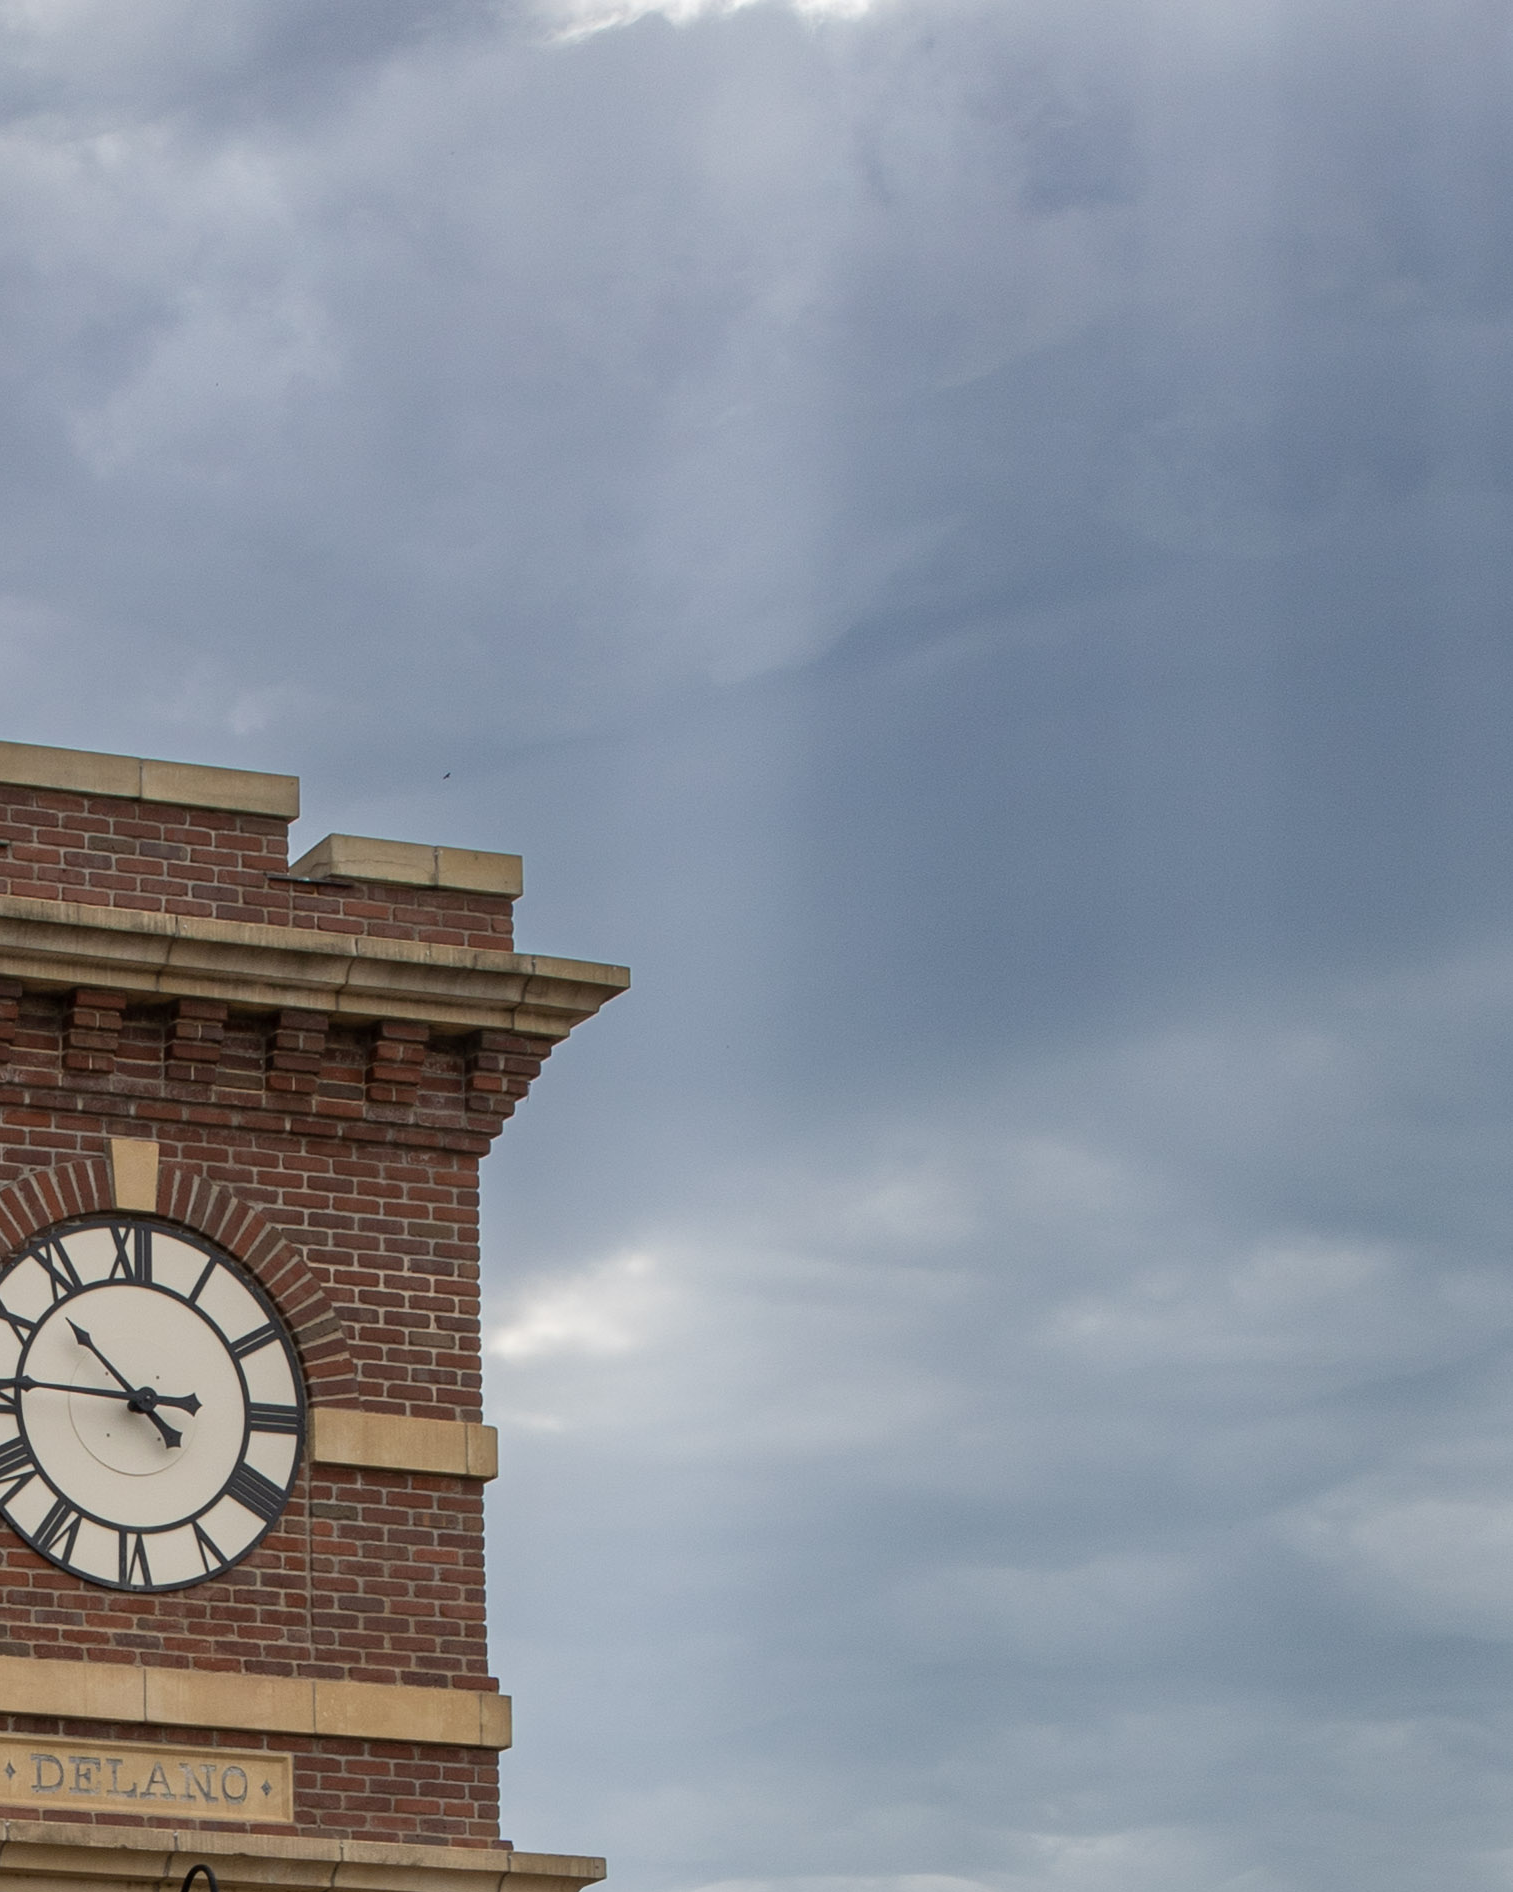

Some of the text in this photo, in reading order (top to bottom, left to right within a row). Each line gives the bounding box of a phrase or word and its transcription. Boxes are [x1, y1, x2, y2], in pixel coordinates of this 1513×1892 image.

[29, 1237, 84, 1304] XI
[108, 1226, 154, 1284] XII
[188, 1256, 219, 1304] I
[229, 1321, 282, 1361] II
[247, 1401, 299, 1436] III
[225, 1461, 287, 1525] IIII
[31, 1497, 83, 1566] VII
[118, 1530, 154, 1587] VI
[190, 1519, 230, 1574] V
[30, 1753, 249, 1805] DELANO
